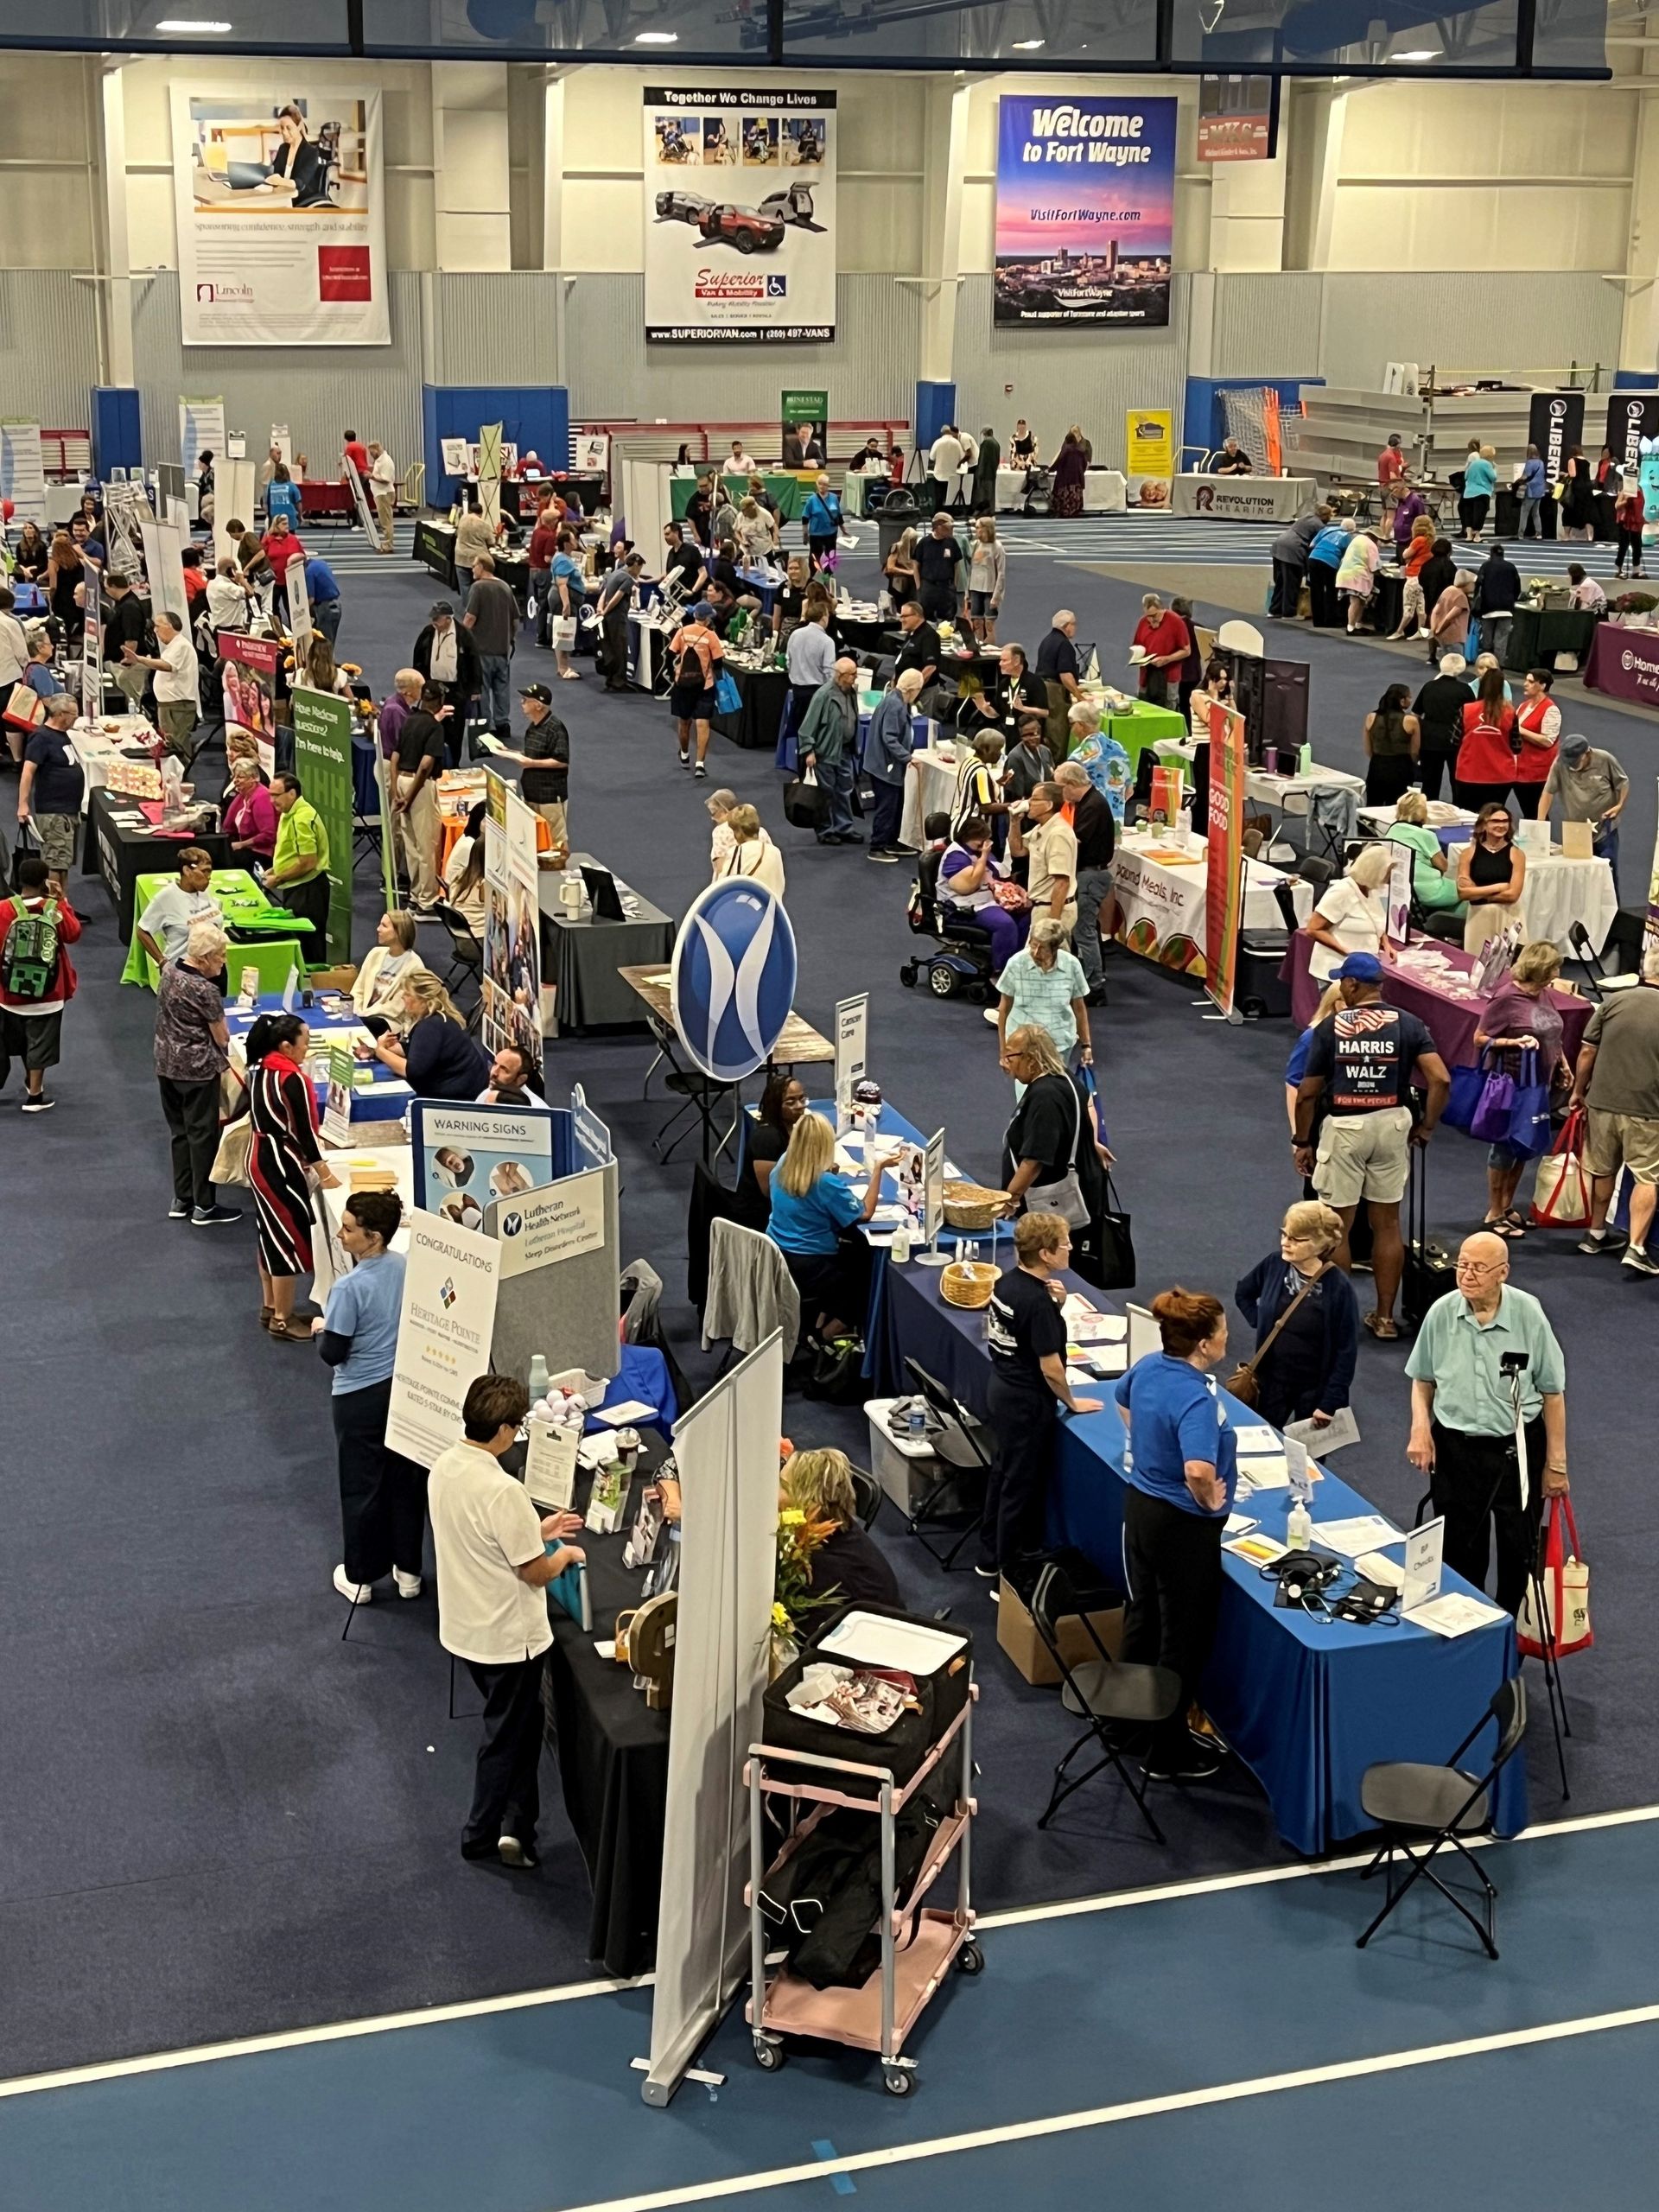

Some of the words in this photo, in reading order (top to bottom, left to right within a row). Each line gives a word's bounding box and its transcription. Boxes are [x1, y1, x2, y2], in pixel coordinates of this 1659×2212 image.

[664, 91, 716, 105] Together
[720, 92, 737, 103] We
[741, 93, 784, 105] Change
[787, 93, 817, 104] Lives
[1032, 105, 1144, 137] Welcome
[1023, 142, 1042, 162] to
[1046, 142, 1084, 162] Fort
[1088, 142, 1151, 166] Wayne
[1030, 209, 1141, 222] VisitFortWayne.com
[695, 269, 765, 288] Superior
[215, 283, 253, 296] Lincoln
[651, 329, 757, 340] www.SUPERIORVAN.com
[1547, 416, 1564, 486] LIBERTY
[1216, 496, 1274, 506] REVOLUTION
[1216, 505, 1274, 515] HEARING
[1141, 874, 1167, 902] Meals,
[1169, 885, 1185, 906] Inc
[1338, 1041, 1395, 1053] HARRIS
[1345, 1065, 1387, 1078] WALZ
[434, 1119, 490, 1134] WARNING
[493, 1124, 526, 1135] SIGNS
[524, 1200, 564, 1220] Lutheran
[524, 1217, 550, 1232] Health
[524, 1231, 556, 1247] Lutheran
[557, 1219, 586, 1236] Hospital
[576, 1231, 598, 1243] Center
[416, 1233, 492, 1273] CONGRATULATIONS
[410, 1302, 450, 1332] HERITAGE
[451, 1320, 481, 1345] POINTE
